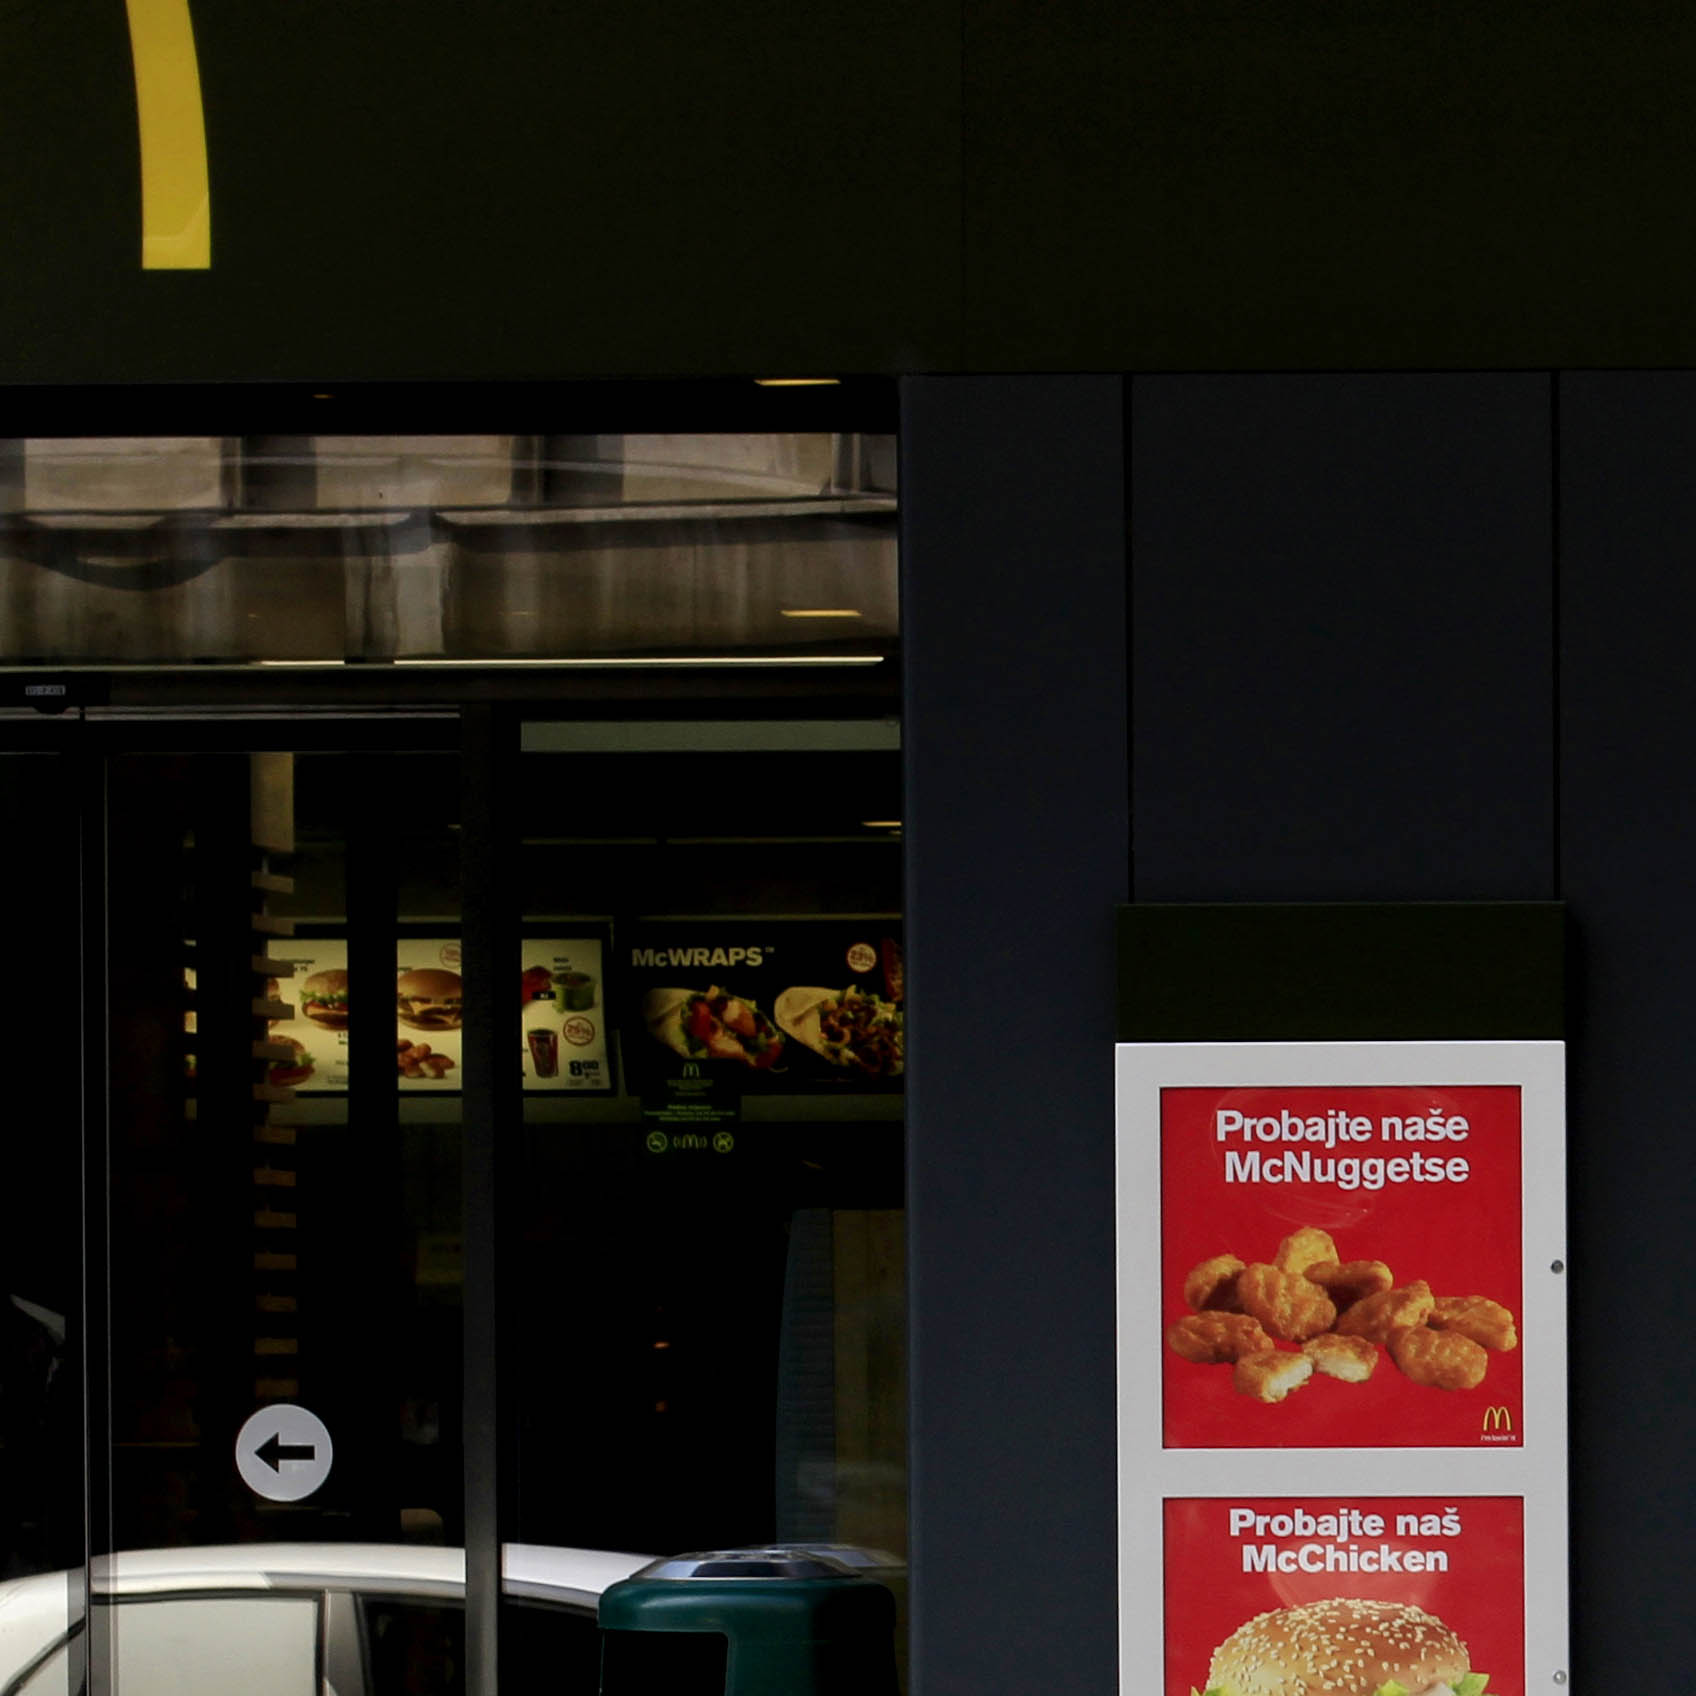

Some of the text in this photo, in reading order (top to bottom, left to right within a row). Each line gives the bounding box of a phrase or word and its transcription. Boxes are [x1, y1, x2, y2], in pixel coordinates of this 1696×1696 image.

[1216, 1108, 1470, 1149] Probajte naše
[1225, 1150, 1470, 1190] McNuggetse
[1229, 1506, 1462, 1543] Probajte naš
[1242, 1543, 1449, 1574] McChicken
